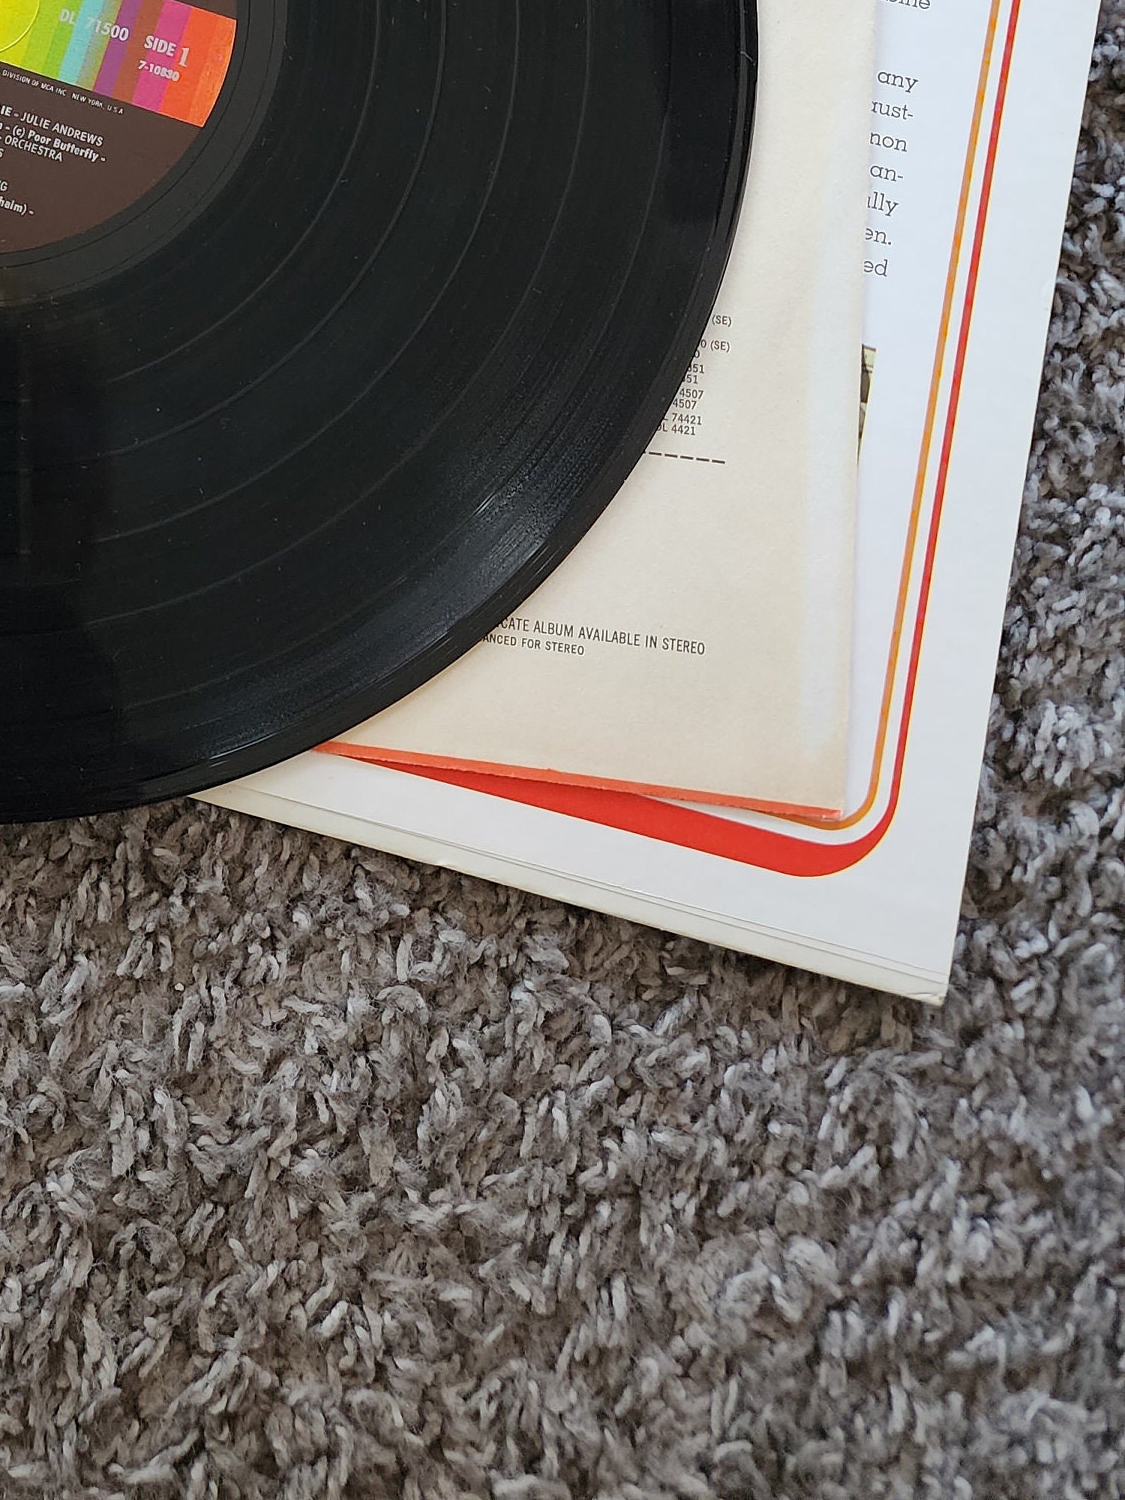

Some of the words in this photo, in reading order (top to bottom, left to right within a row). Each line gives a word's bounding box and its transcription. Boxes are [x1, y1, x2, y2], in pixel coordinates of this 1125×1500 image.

[58, 8, 75, 25] DL
[84, 16, 130, 42] 71500
[143, 35, 177, 57] SIDE
[877, 69, 920, 94] any
[20, 112, 51, 130] JULIE
[52, 122, 104, 147] ANDREWS
[4, 135, 64, 162] ORCHESTRA
[12, 124, 26, 138] (c)
[28, 130, 52, 145] Poor
[53, 139, 100, 163] Butterfly
[671, 413, 702, 426] 74421
[671, 425, 696, 436] 4421
[521, 637, 541, 650] FOR
[545, 640, 585, 656] STEREO
[533, 620, 574, 638] ALBUM
[577, 626, 641, 648] AVAILABLE
[645, 635, 657, 649] IN
[661, 636, 705, 656] STEREO
